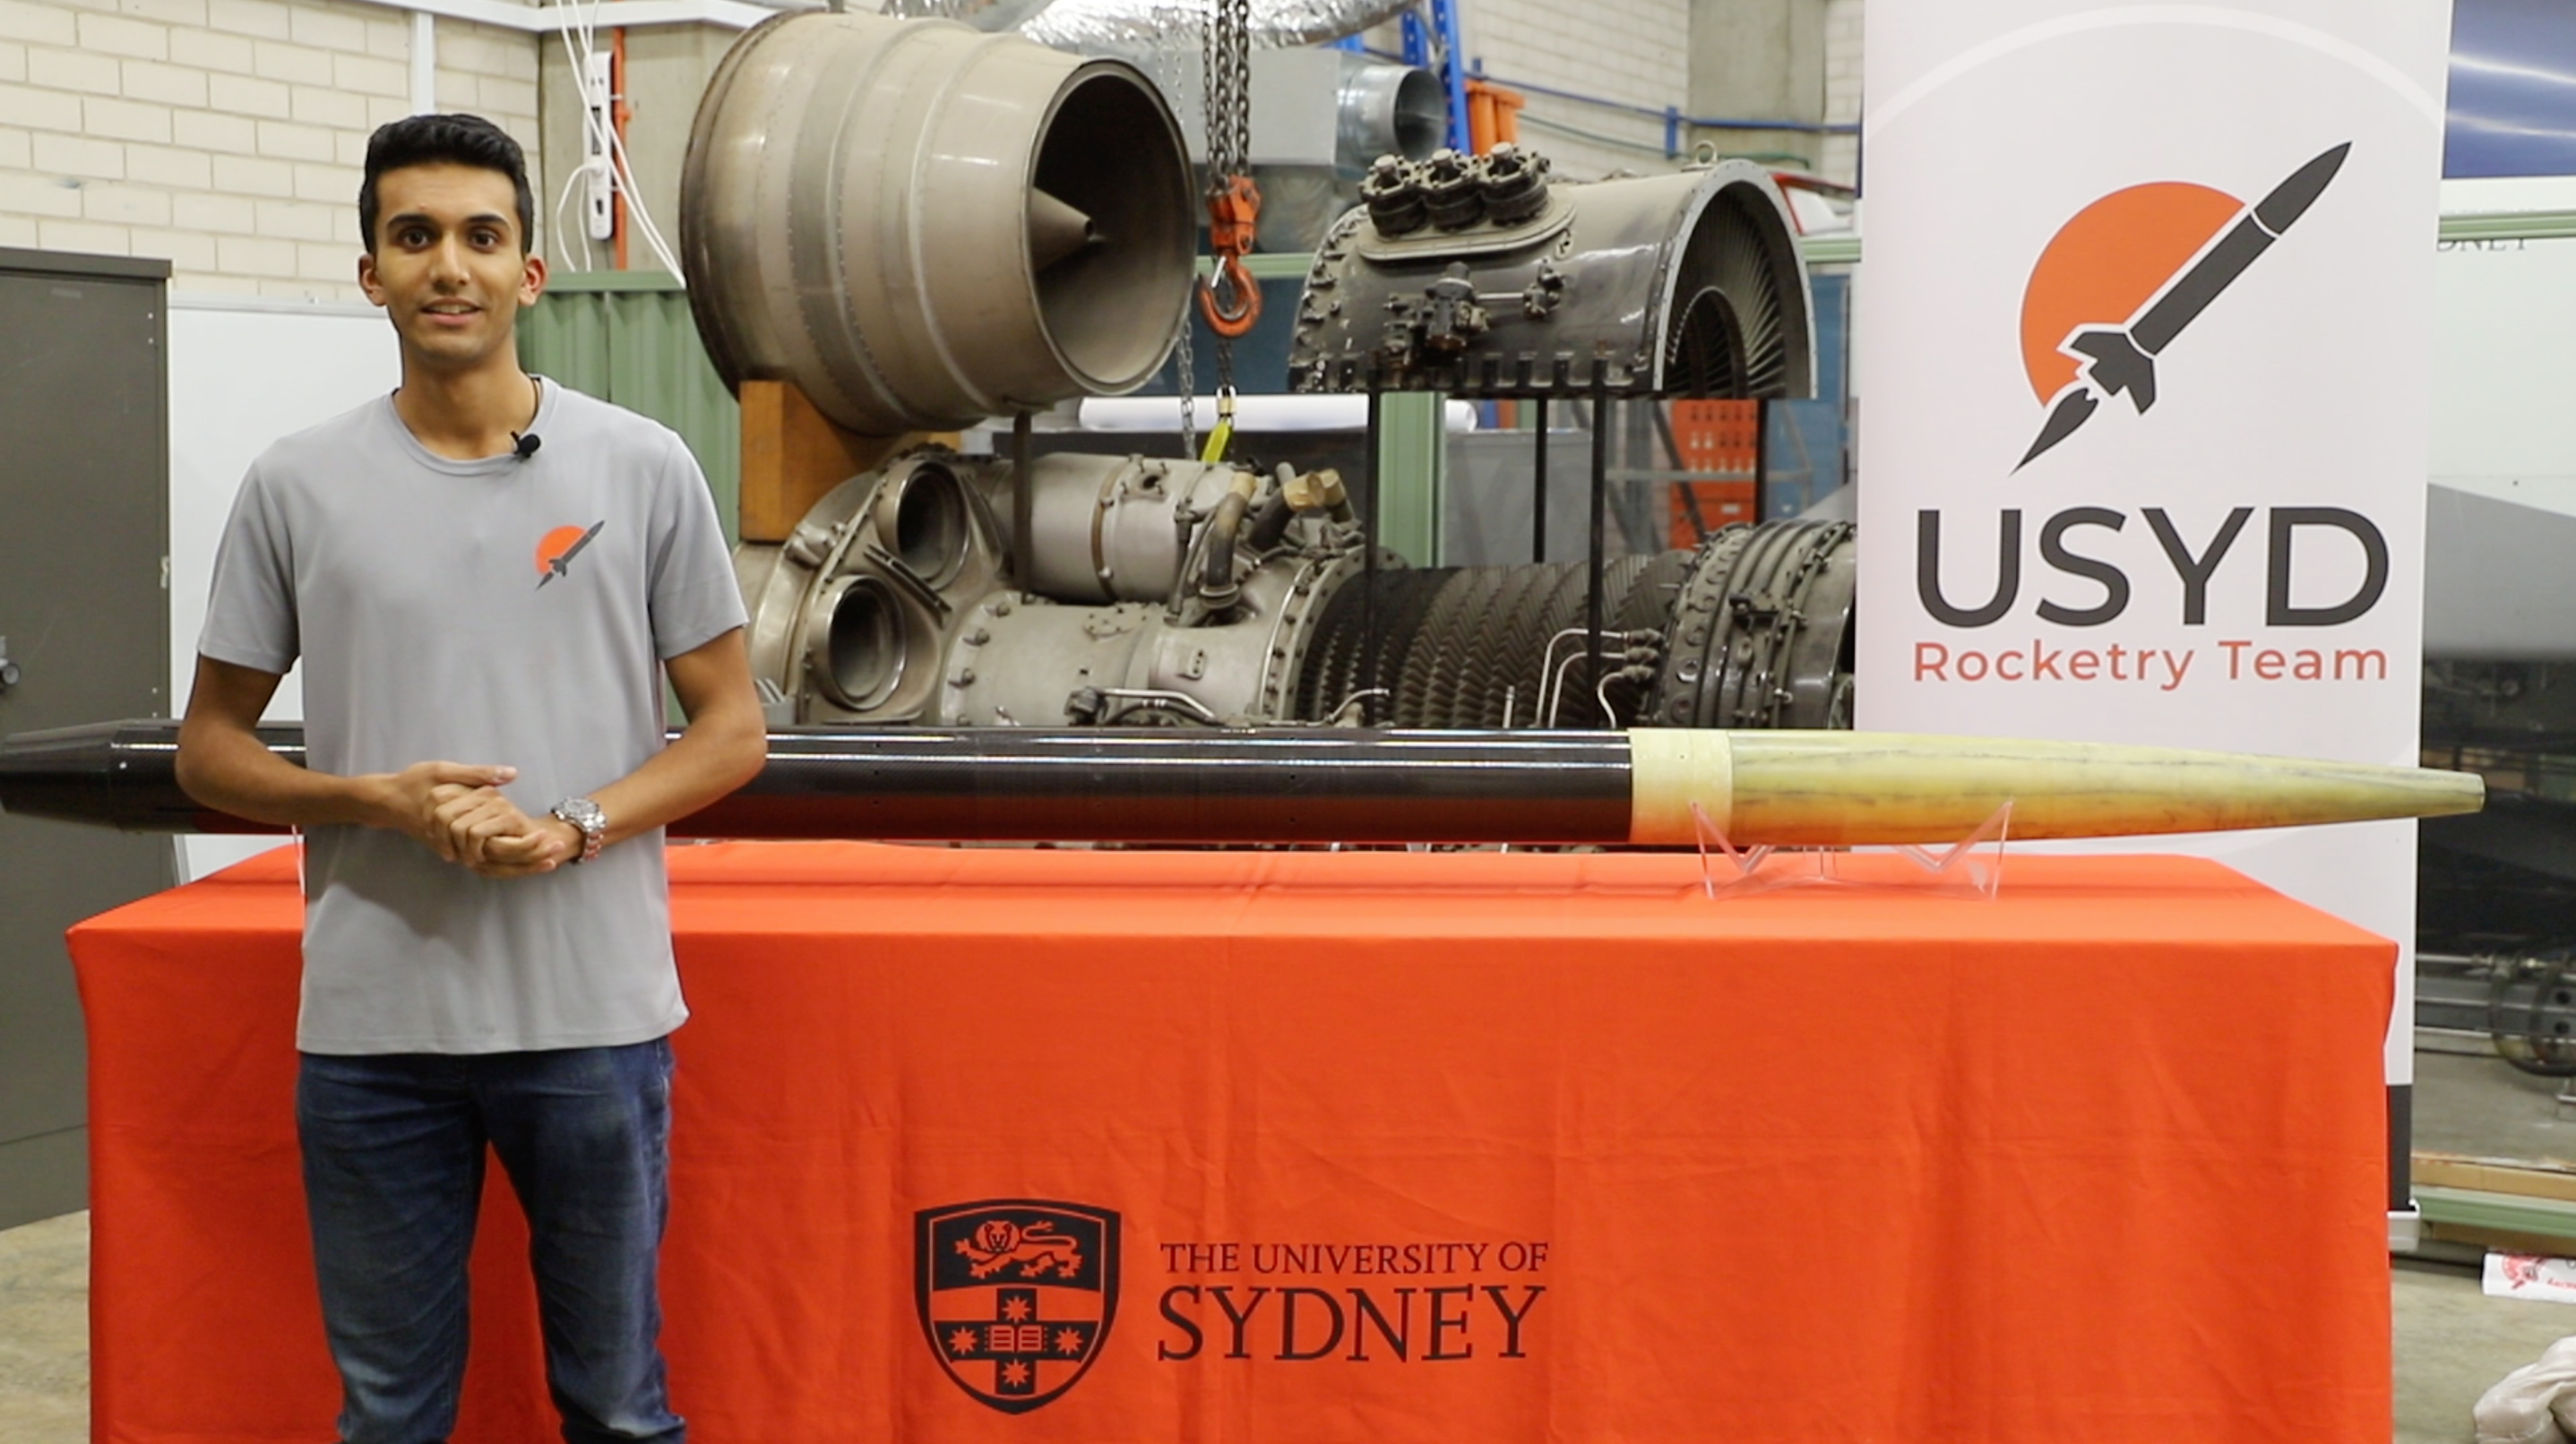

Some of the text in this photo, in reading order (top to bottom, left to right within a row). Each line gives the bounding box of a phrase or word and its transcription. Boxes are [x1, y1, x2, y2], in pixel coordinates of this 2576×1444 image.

[1917, 506, 2390, 629] USYD
[1914, 639, 2387, 692] Rocketry Team
[1160, 1242, 1548, 1275] THE UNIVERSITY OF
[1159, 1284, 1547, 1362] SYDNEY
